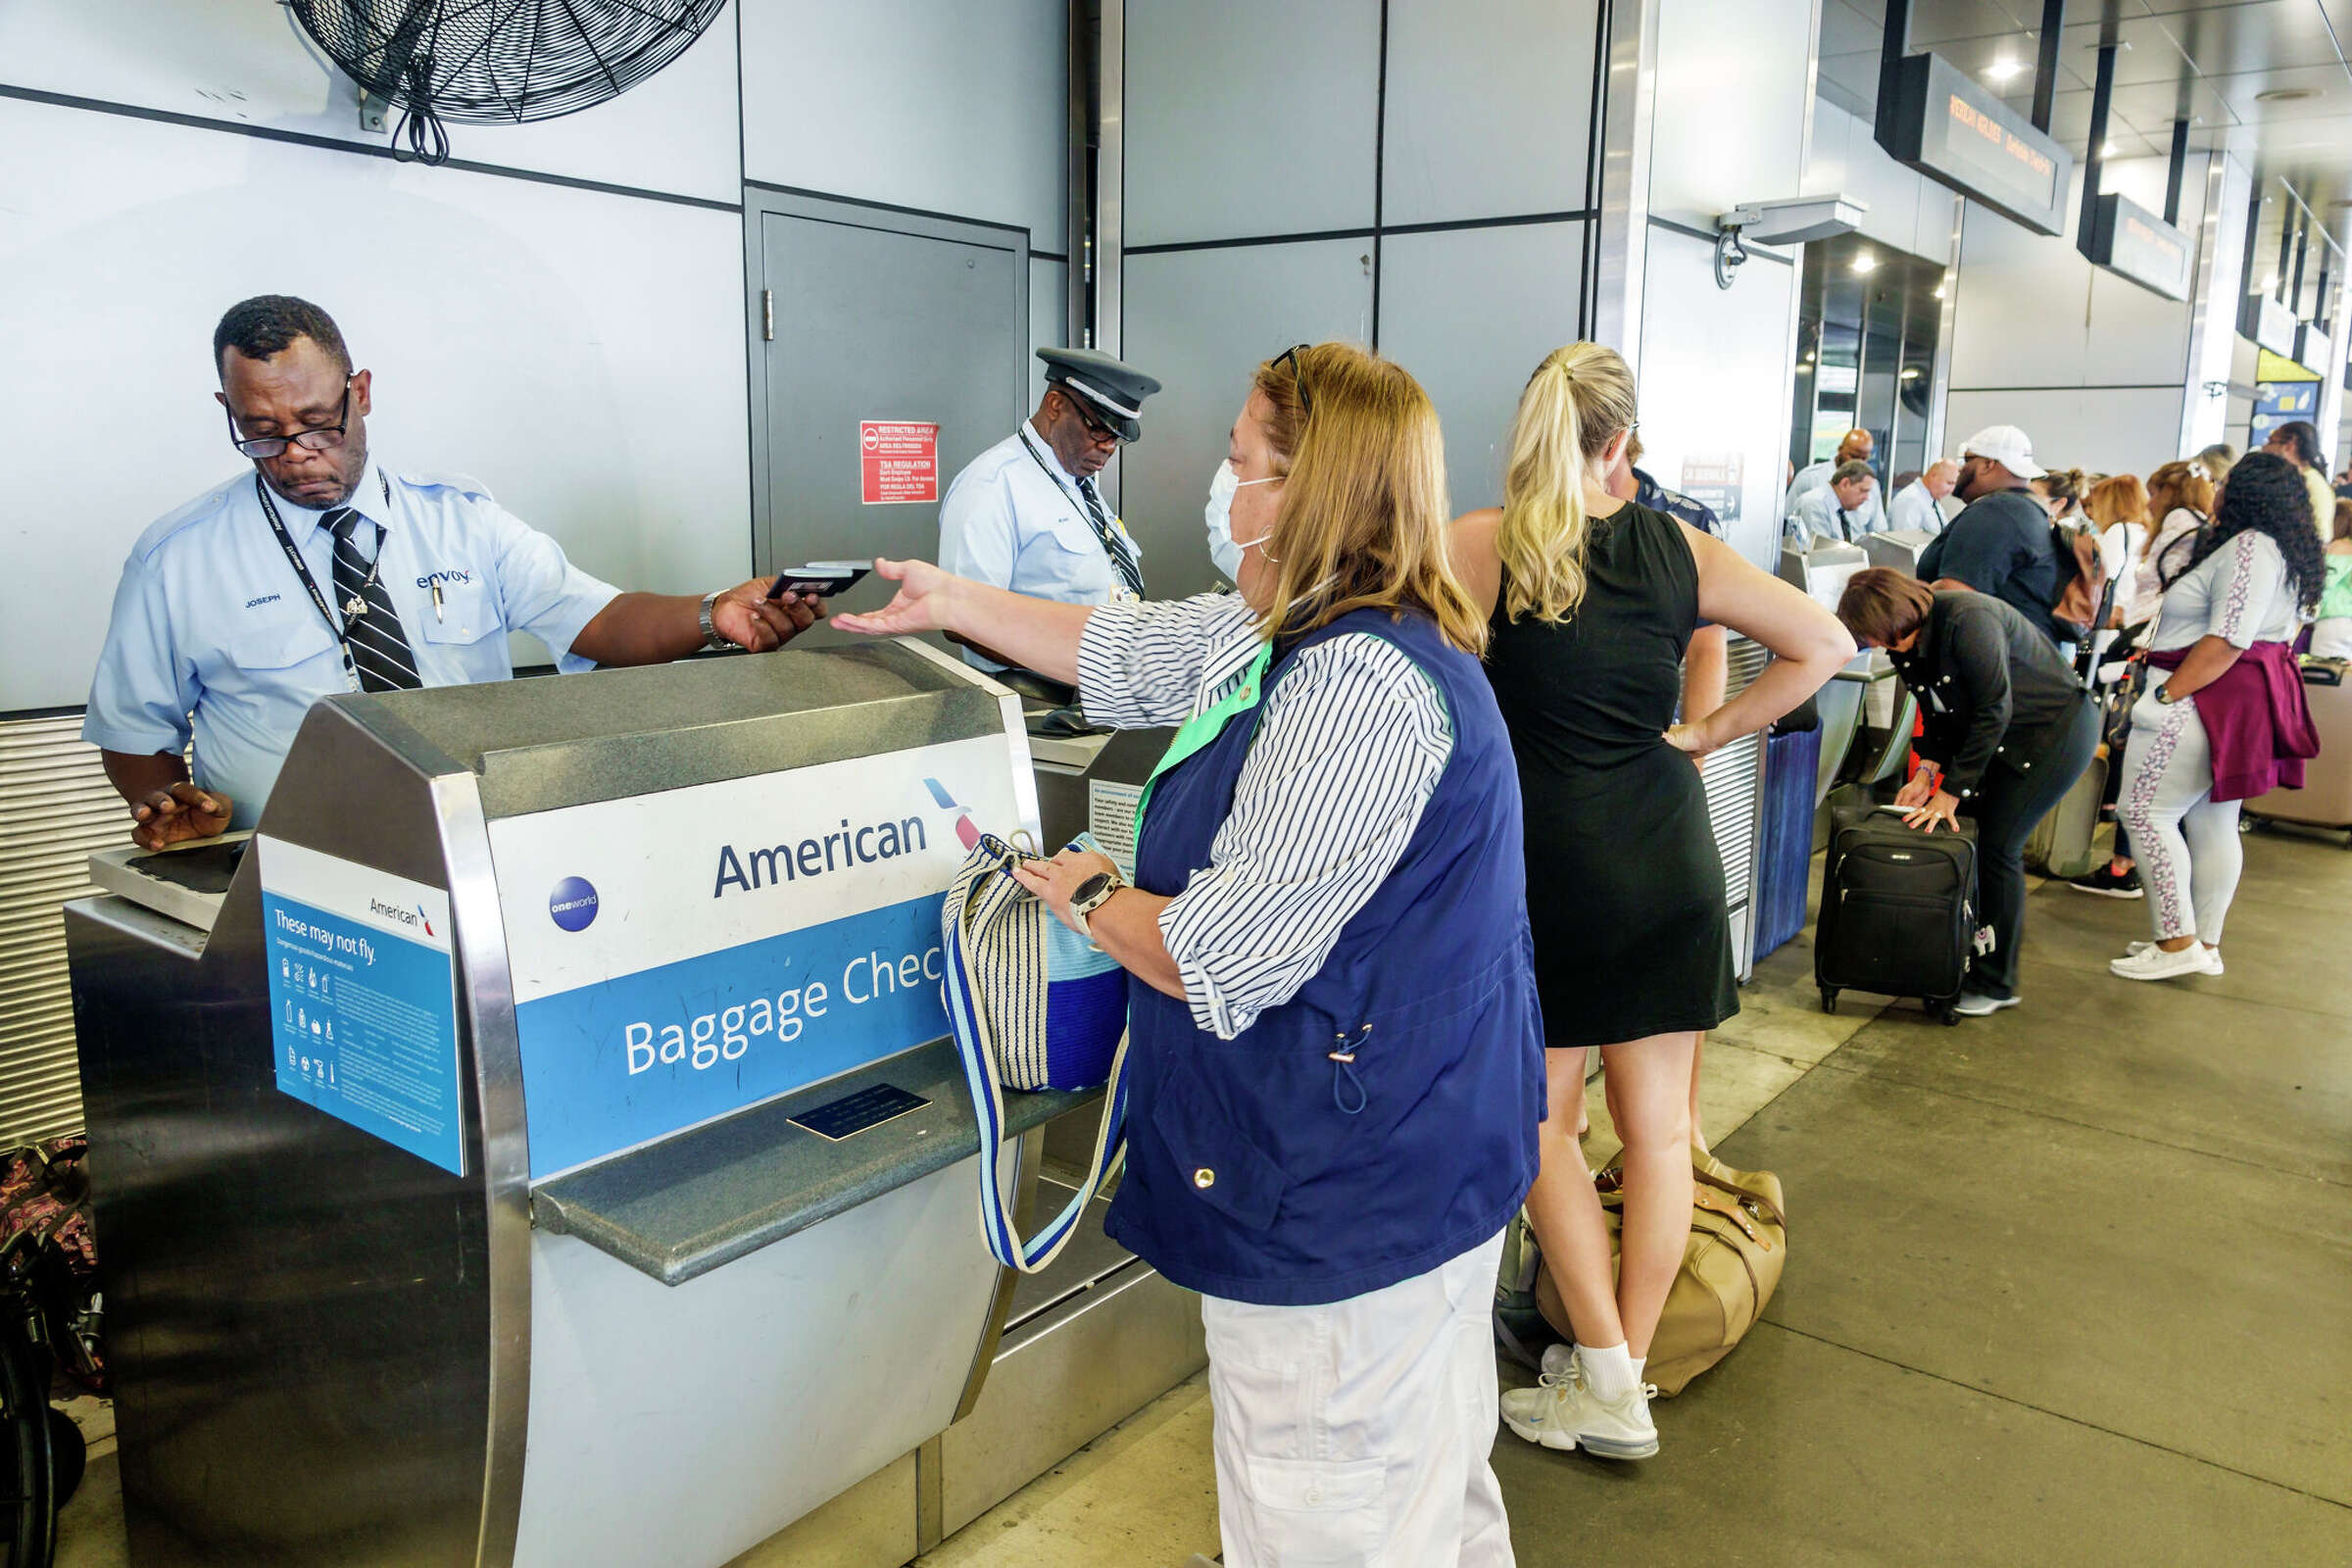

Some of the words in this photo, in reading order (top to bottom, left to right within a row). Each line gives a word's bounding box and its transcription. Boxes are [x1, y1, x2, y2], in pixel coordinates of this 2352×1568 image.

[879, 426, 916, 434] RESTRICTED
[880, 461, 892, 469] TSA
[893, 461, 931, 469] REGULATION
[416, 569, 469, 588] envoy
[245, 593, 281, 609] JOSEPH
[713, 815, 927, 899] American
[369, 898, 417, 927] American
[551, 894, 598, 913] oneworld
[274, 908, 308, 937] These
[309, 925, 334, 952] may
[336, 935, 358, 956] not
[358, 938, 377, 966] fly.
[625, 980, 828, 1075] Baggage
[843, 947, 942, 1004] Chec
